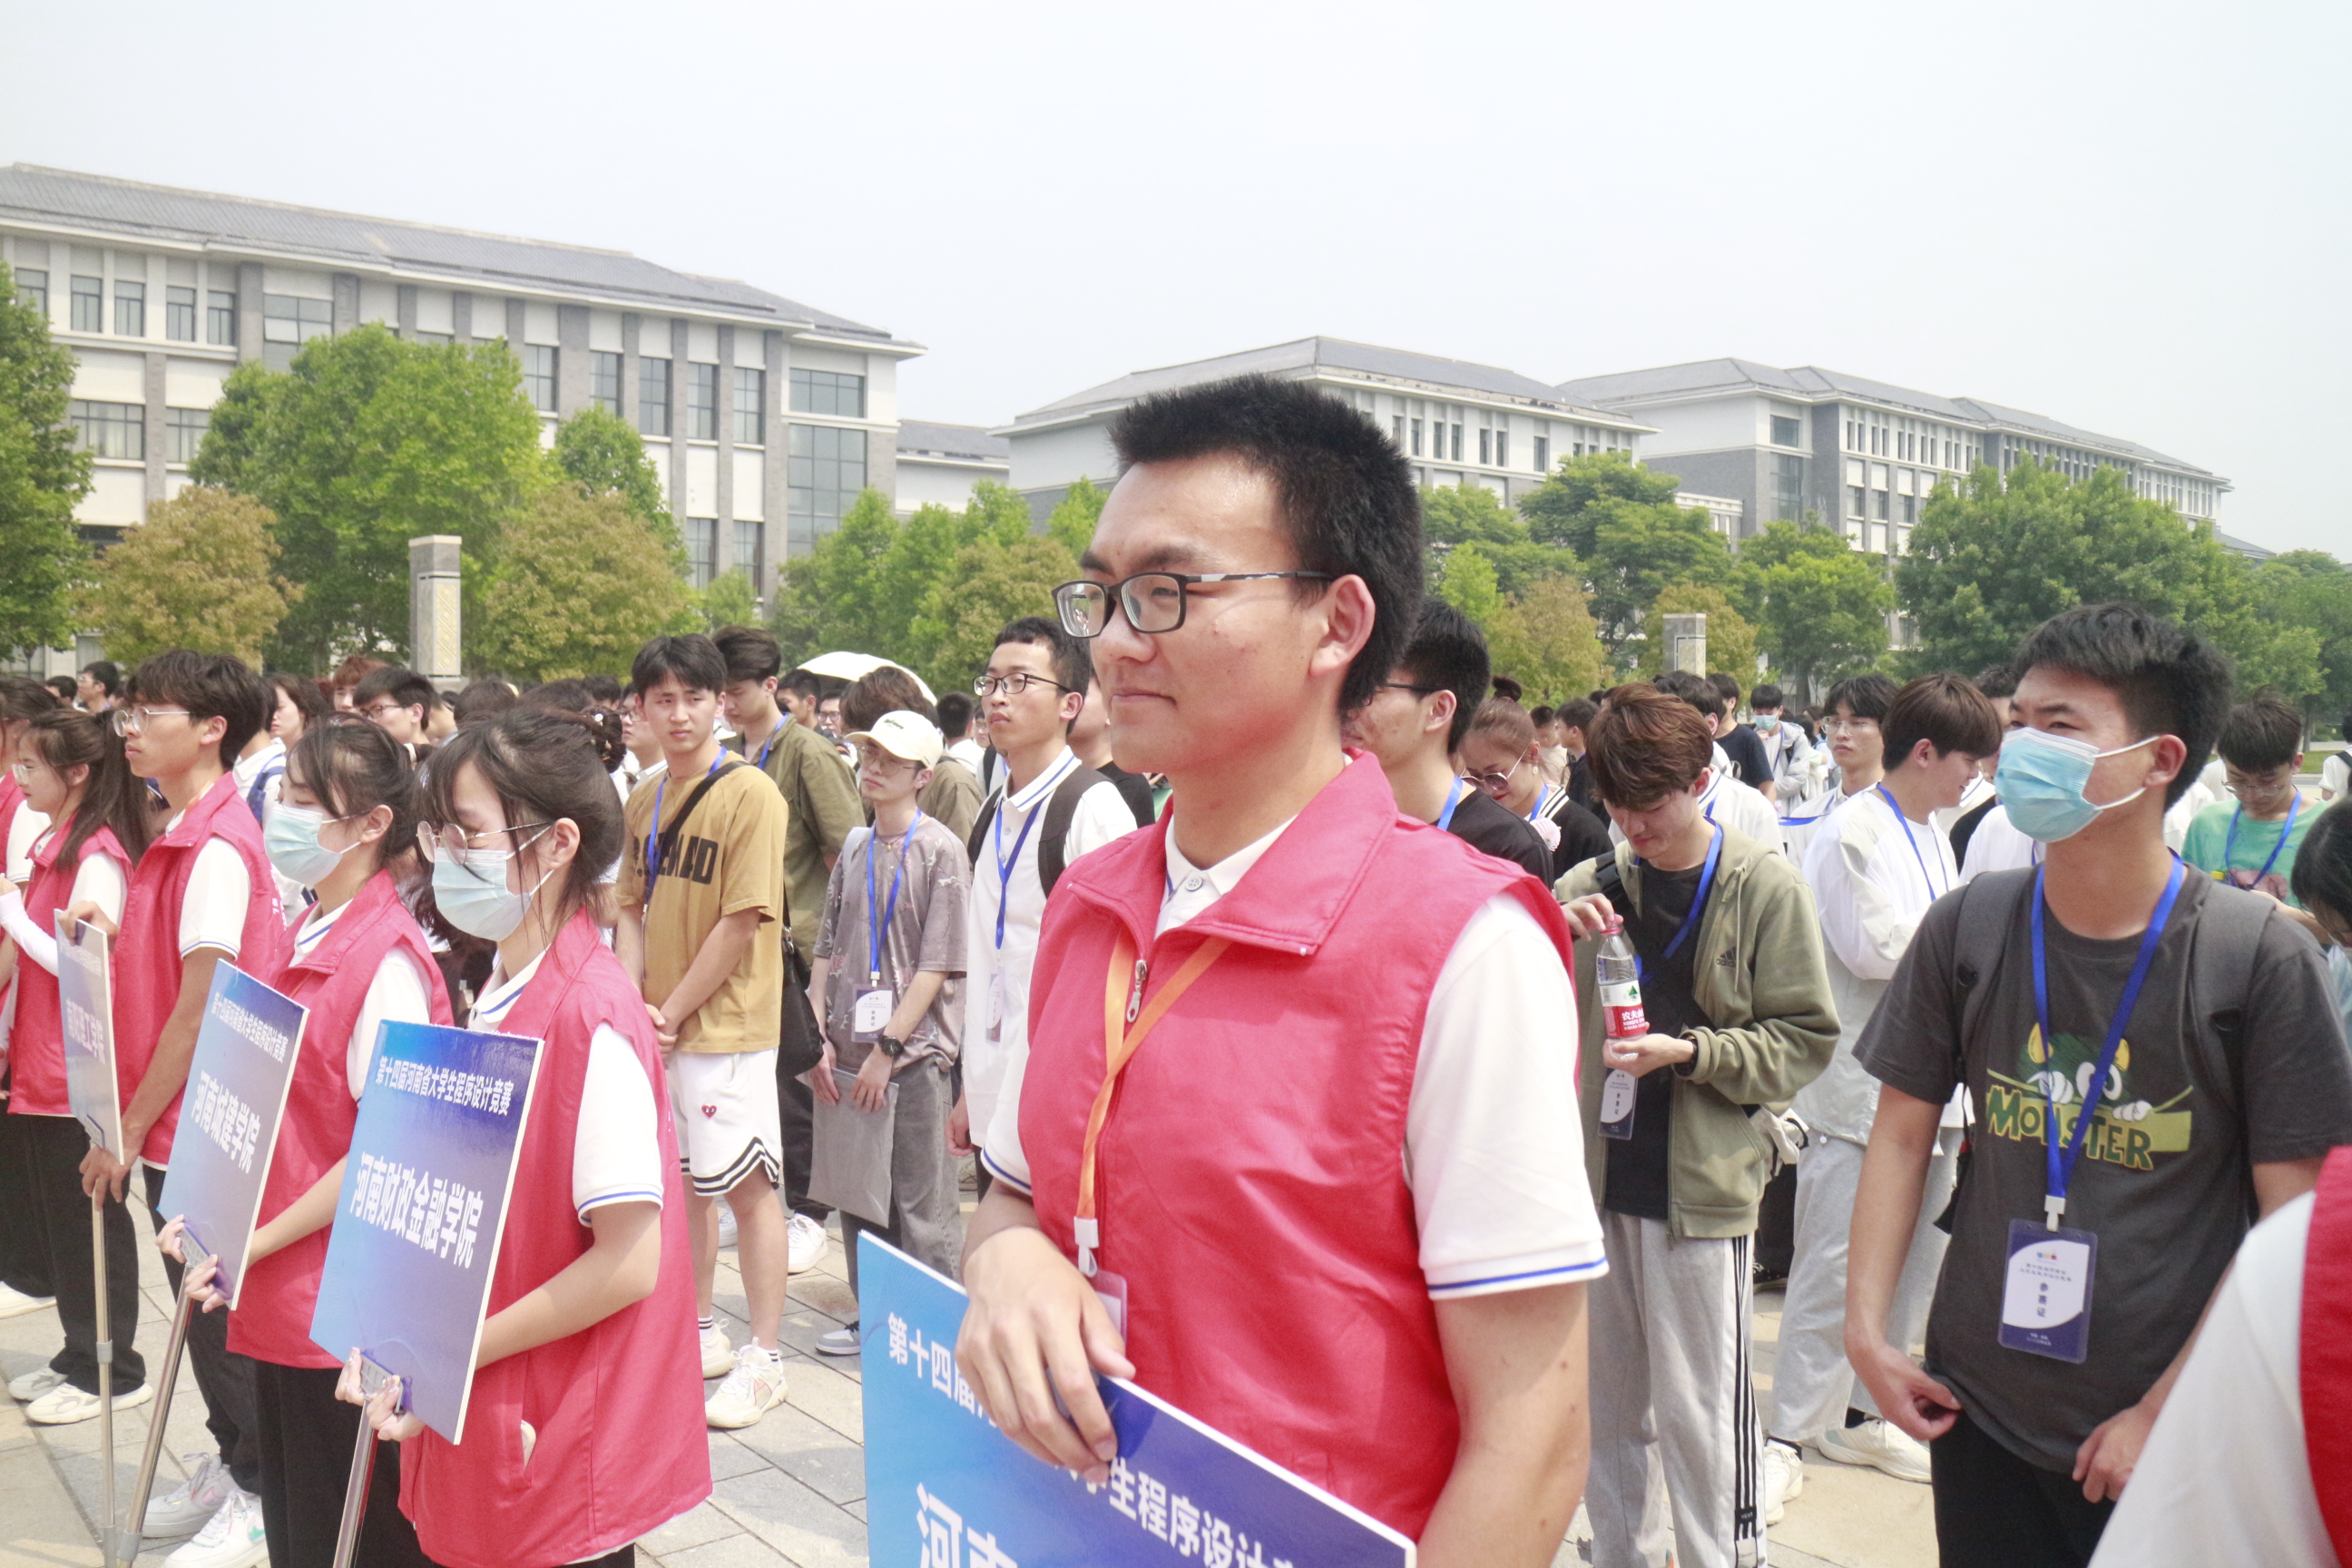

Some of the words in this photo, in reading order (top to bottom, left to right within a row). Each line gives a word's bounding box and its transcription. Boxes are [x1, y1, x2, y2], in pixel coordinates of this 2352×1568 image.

[211, 991, 289, 1063] 第十四届河南省大学生程序设计竞赛
[191, 1070, 260, 1174] 河南城建学院
[376, 1055, 514, 1117] 第十四届河南省大学生程序设计竞赛
[349, 1152, 484, 1269] 河南财政金融学院
